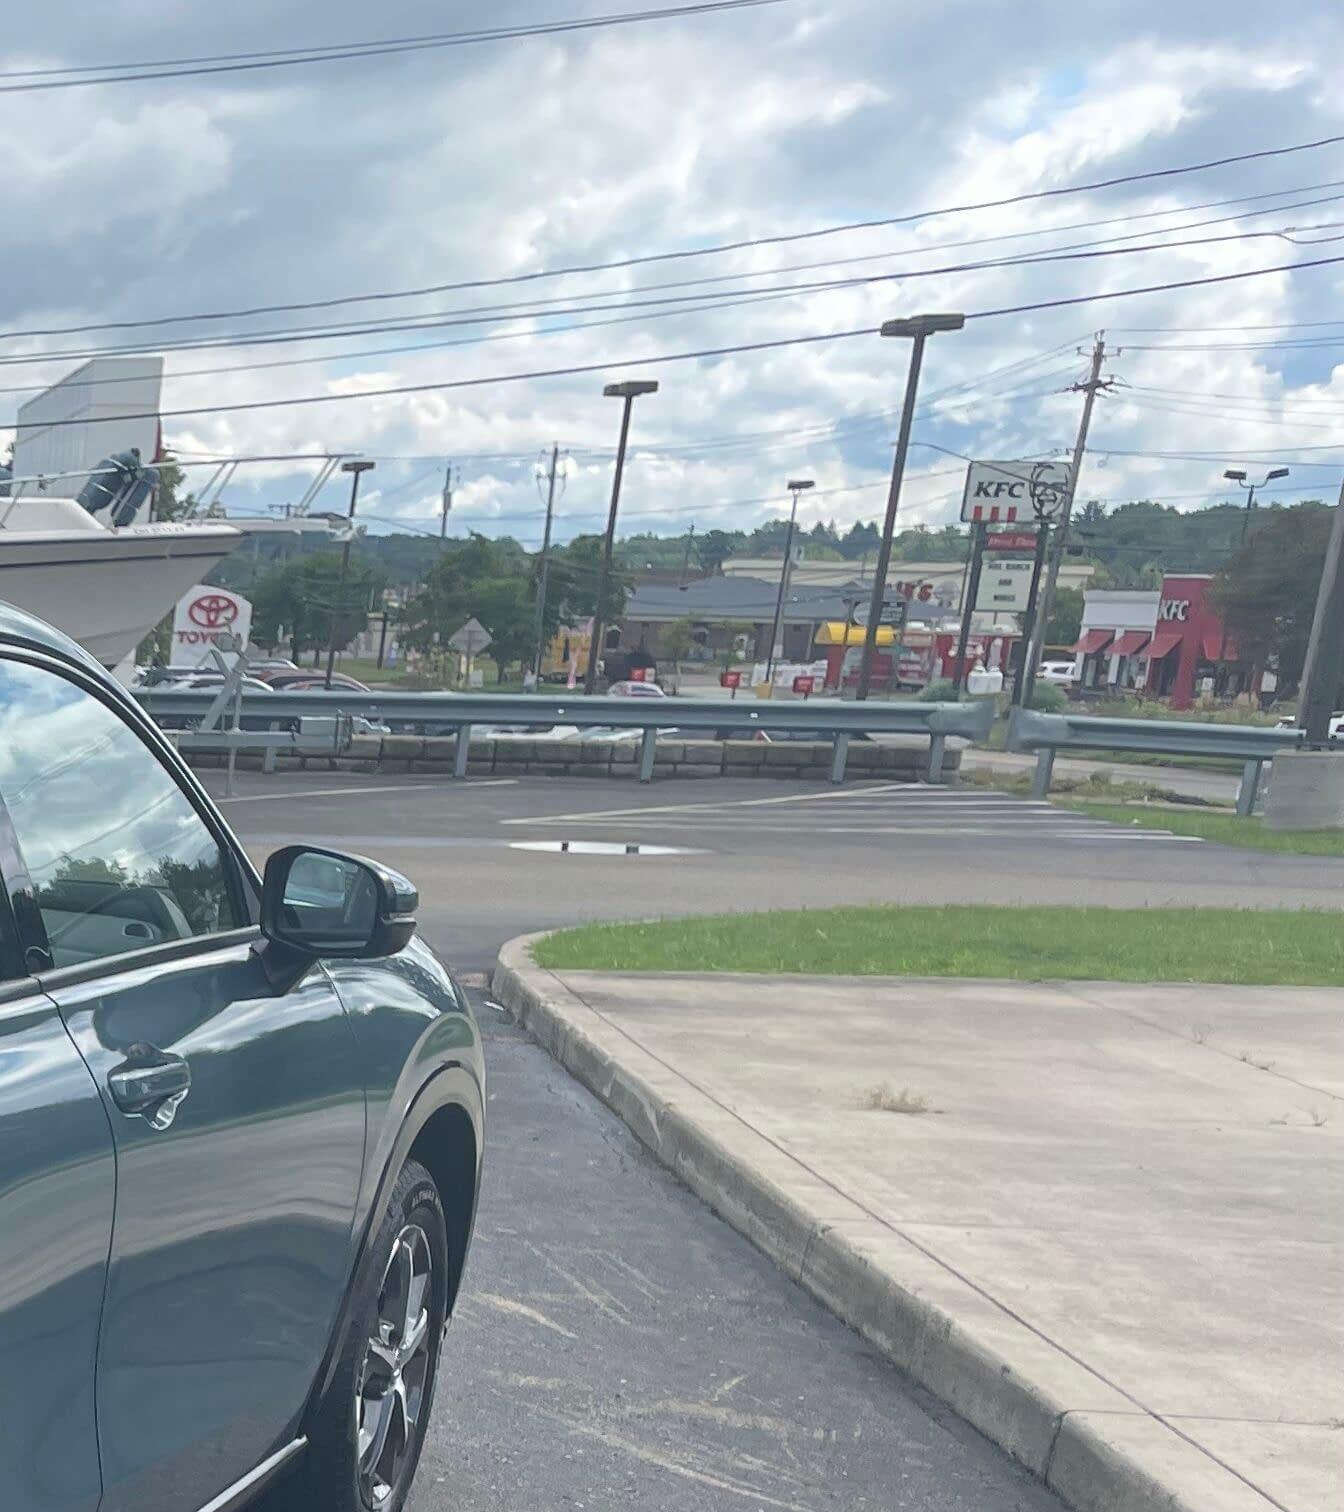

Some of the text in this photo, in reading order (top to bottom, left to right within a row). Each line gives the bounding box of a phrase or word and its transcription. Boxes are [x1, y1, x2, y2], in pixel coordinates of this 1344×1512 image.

[973, 481, 1025, 498] KFC
[1158, 599, 1190, 621] KFC
[178, 630, 243, 645] TOYA
